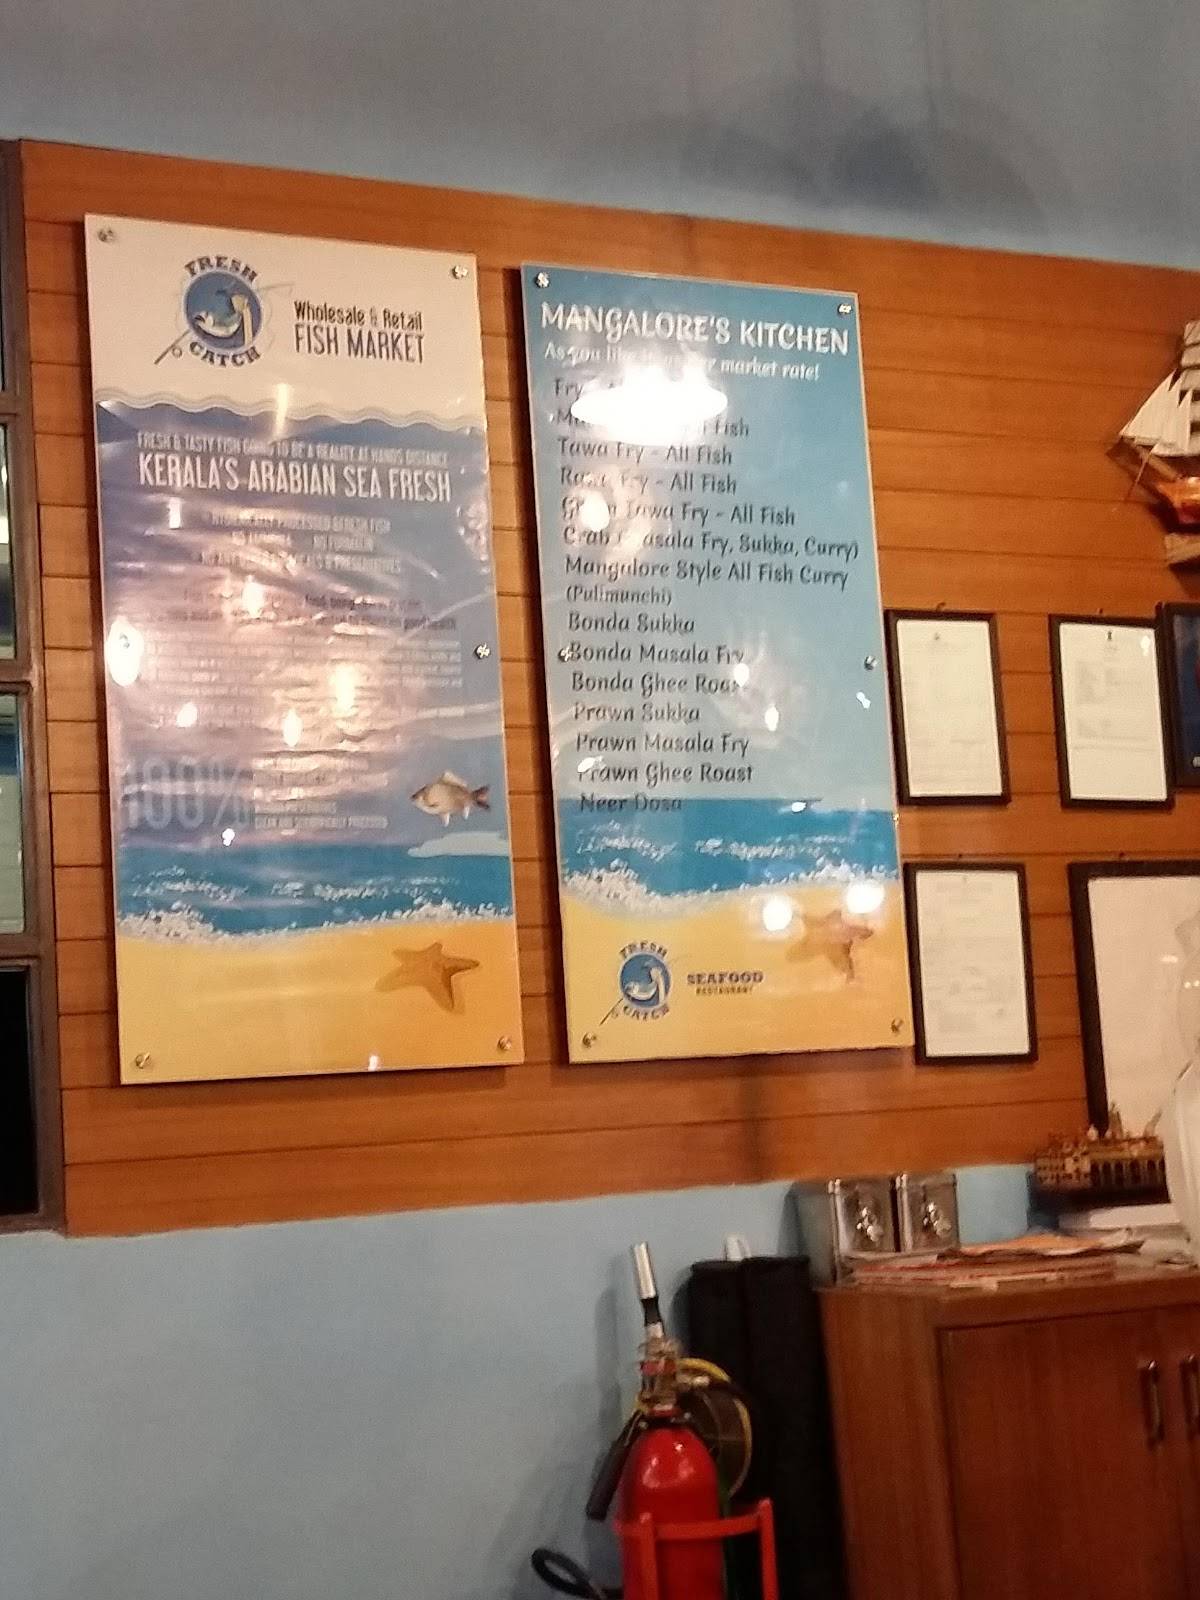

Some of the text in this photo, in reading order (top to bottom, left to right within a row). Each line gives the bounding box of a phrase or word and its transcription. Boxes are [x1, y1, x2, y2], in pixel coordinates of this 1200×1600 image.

[185, 256, 258, 282] FRESH
[294, 301, 365, 326] Wholesale
[382, 311, 423, 331] Retail
[541, 302, 849, 355] MANGALORE'S KITCHEN
[189, 342, 261, 367] CATCH
[294, 324, 424, 363] FISH MARKET
[721, 359, 776, 378] market
[782, 364, 819, 381] rate!
[714, 418, 750, 437] Fish
[557, 437, 608, 458] Tawa
[616, 441, 644, 463] Fry
[666, 445, 690, 462] All
[697, 447, 732, 466] Fish
[138, 452, 451, 502] KERALA'S ARABIAN SEA FRESH
[670, 471, 694, 491] All
[702, 474, 737, 495] Fish
[682, 501, 709, 527] Fry
[730, 505, 754, 525] All
[761, 507, 795, 527] Fish
[563, 525, 610, 546] Crab
[701, 531, 733, 557] Fry,
[740, 533, 799, 558] Sukka,
[804, 536, 859, 567] Curry)
[565, 554, 848, 592] Mangalore Style All Fish Curry
[565, 584, 672, 606] (Pulimunchi)
[568, 611, 695, 635] Bonda Sukka
[570, 641, 745, 665] Bonda Masala Fry
[571, 671, 633, 692] Bonda
[640, 673, 687, 699] Ghee
[573, 702, 700, 725] Prawn Sukka
[576, 732, 749, 758] Prawn Masala Fry
[646, 764, 693, 788] Ghee
[700, 764, 753, 783] Roast
[580, 793, 682, 812] Neer Dosa
[619, 940, 668, 960] FRESH
[687, 970, 764, 986] SEAFOOD
